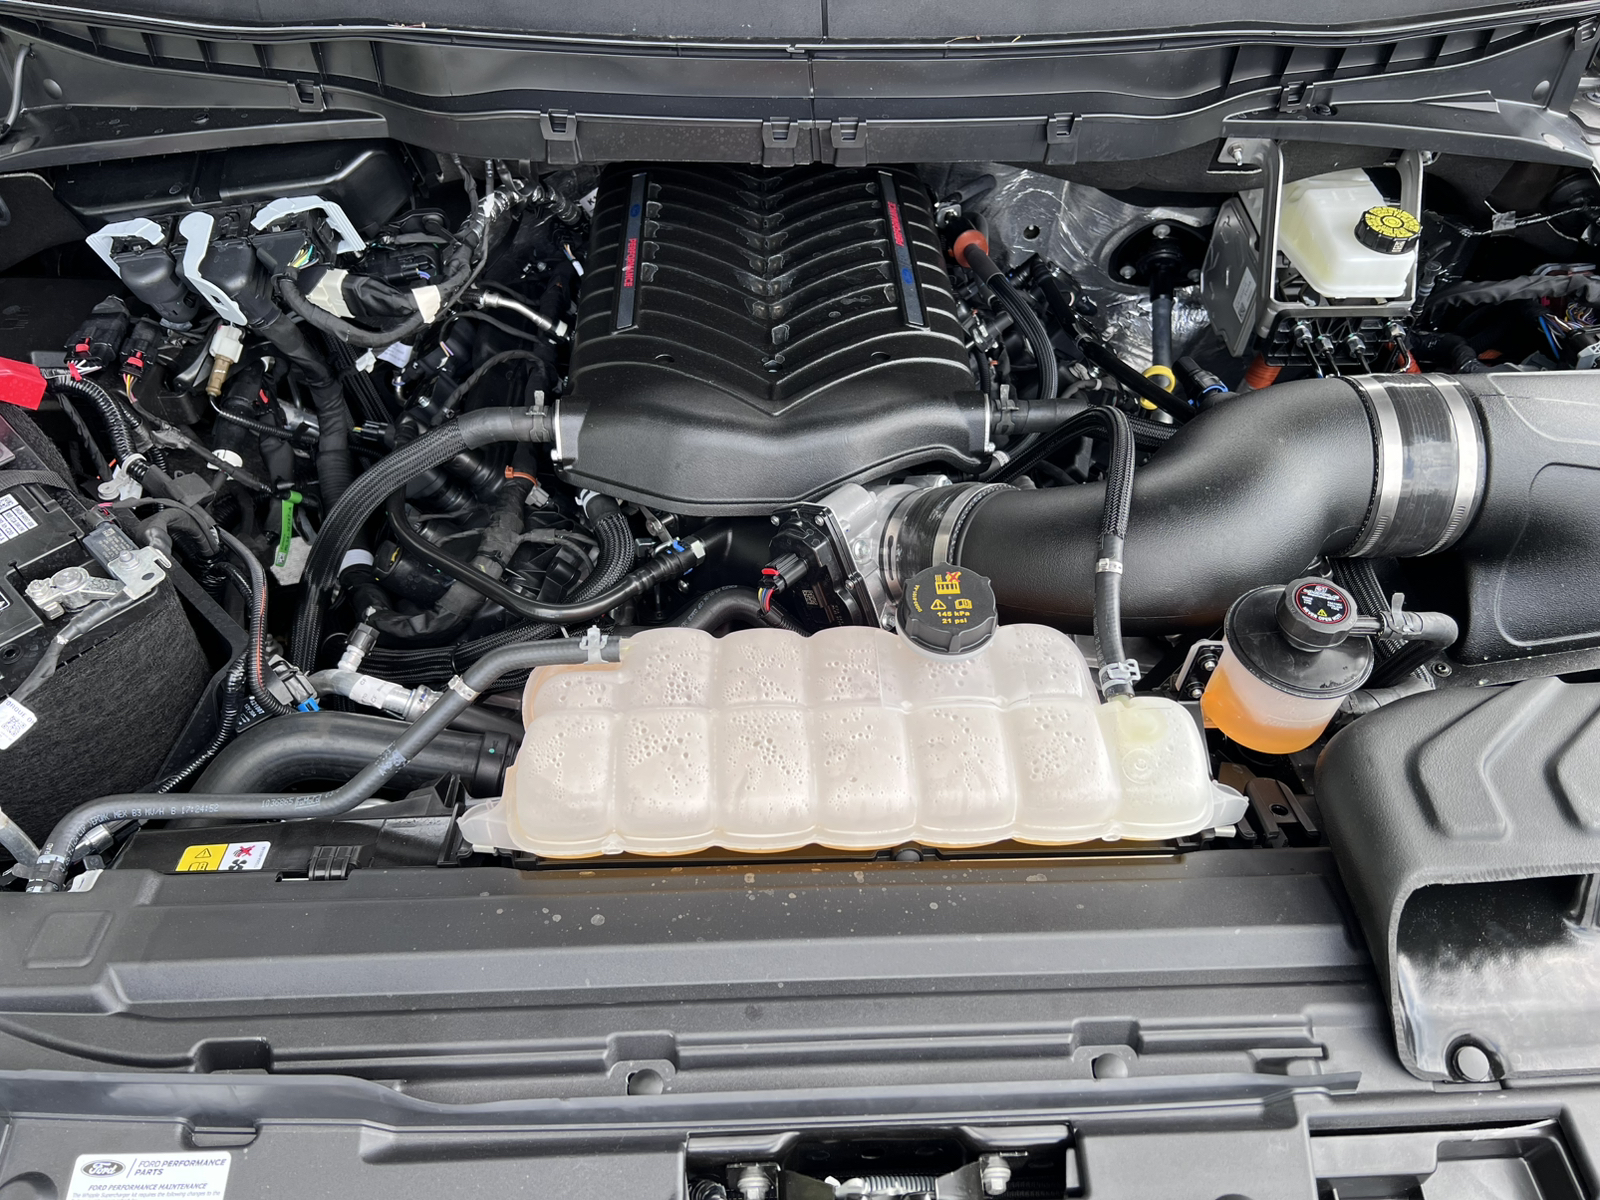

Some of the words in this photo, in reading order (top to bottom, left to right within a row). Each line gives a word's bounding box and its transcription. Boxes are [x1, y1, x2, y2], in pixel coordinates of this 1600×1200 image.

[624, 238, 638, 288] PERFORMANCE
[1302, 606, 1318, 619] NEVER
[181, 803, 220, 815] 17:24:52
[138, 1160, 161, 1168] FORD
[161, 1158, 227, 1168] PERFORMANCE
[134, 1168, 164, 1176] PARTS
[108, 1183, 158, 1191] PERFORMANCE
[158, 1182, 208, 1190] MAINTENANCE
